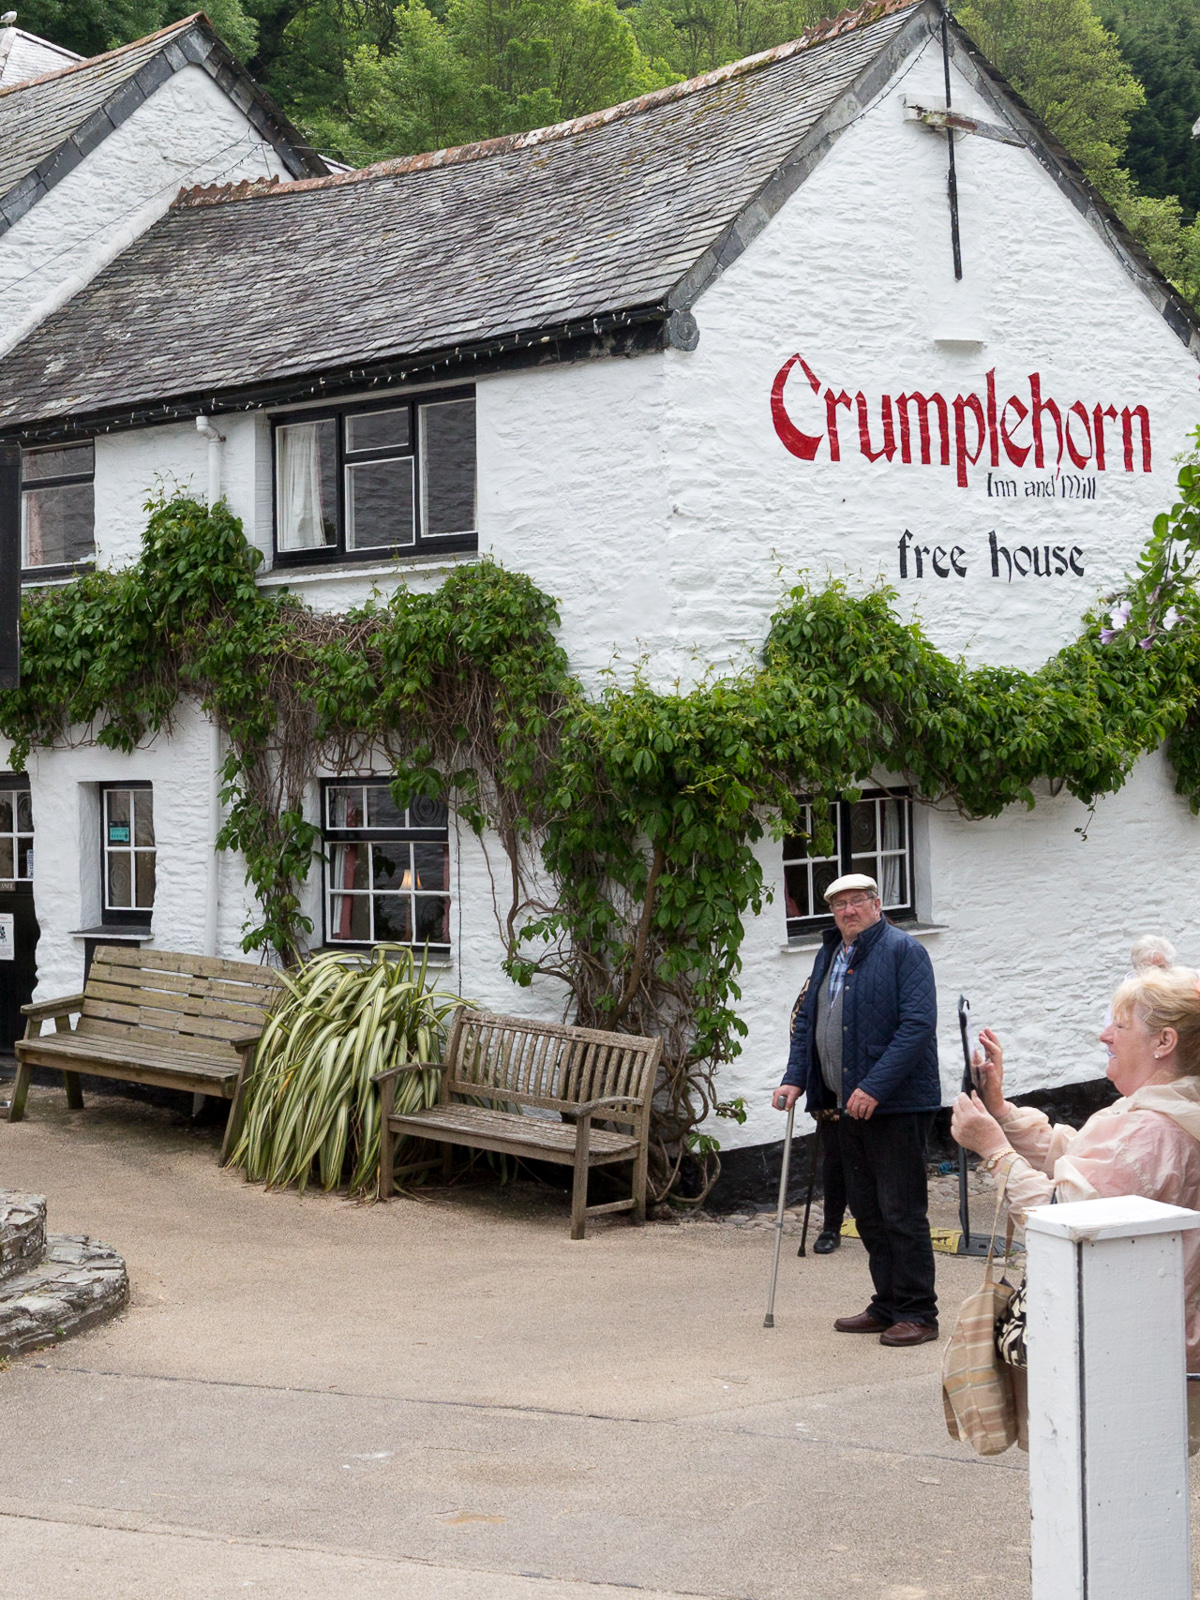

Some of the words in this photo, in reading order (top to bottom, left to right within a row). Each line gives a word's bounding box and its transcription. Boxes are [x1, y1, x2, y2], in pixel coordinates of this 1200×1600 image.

[770, 353, 1152, 488] Crumplehorn
[987, 473, 1017, 498] Inn
[1024, 475, 1056, 498] and
[1061, 475, 1096, 500] Mill
[898, 529, 968, 579] free
[988, 530, 1085, 582] house
